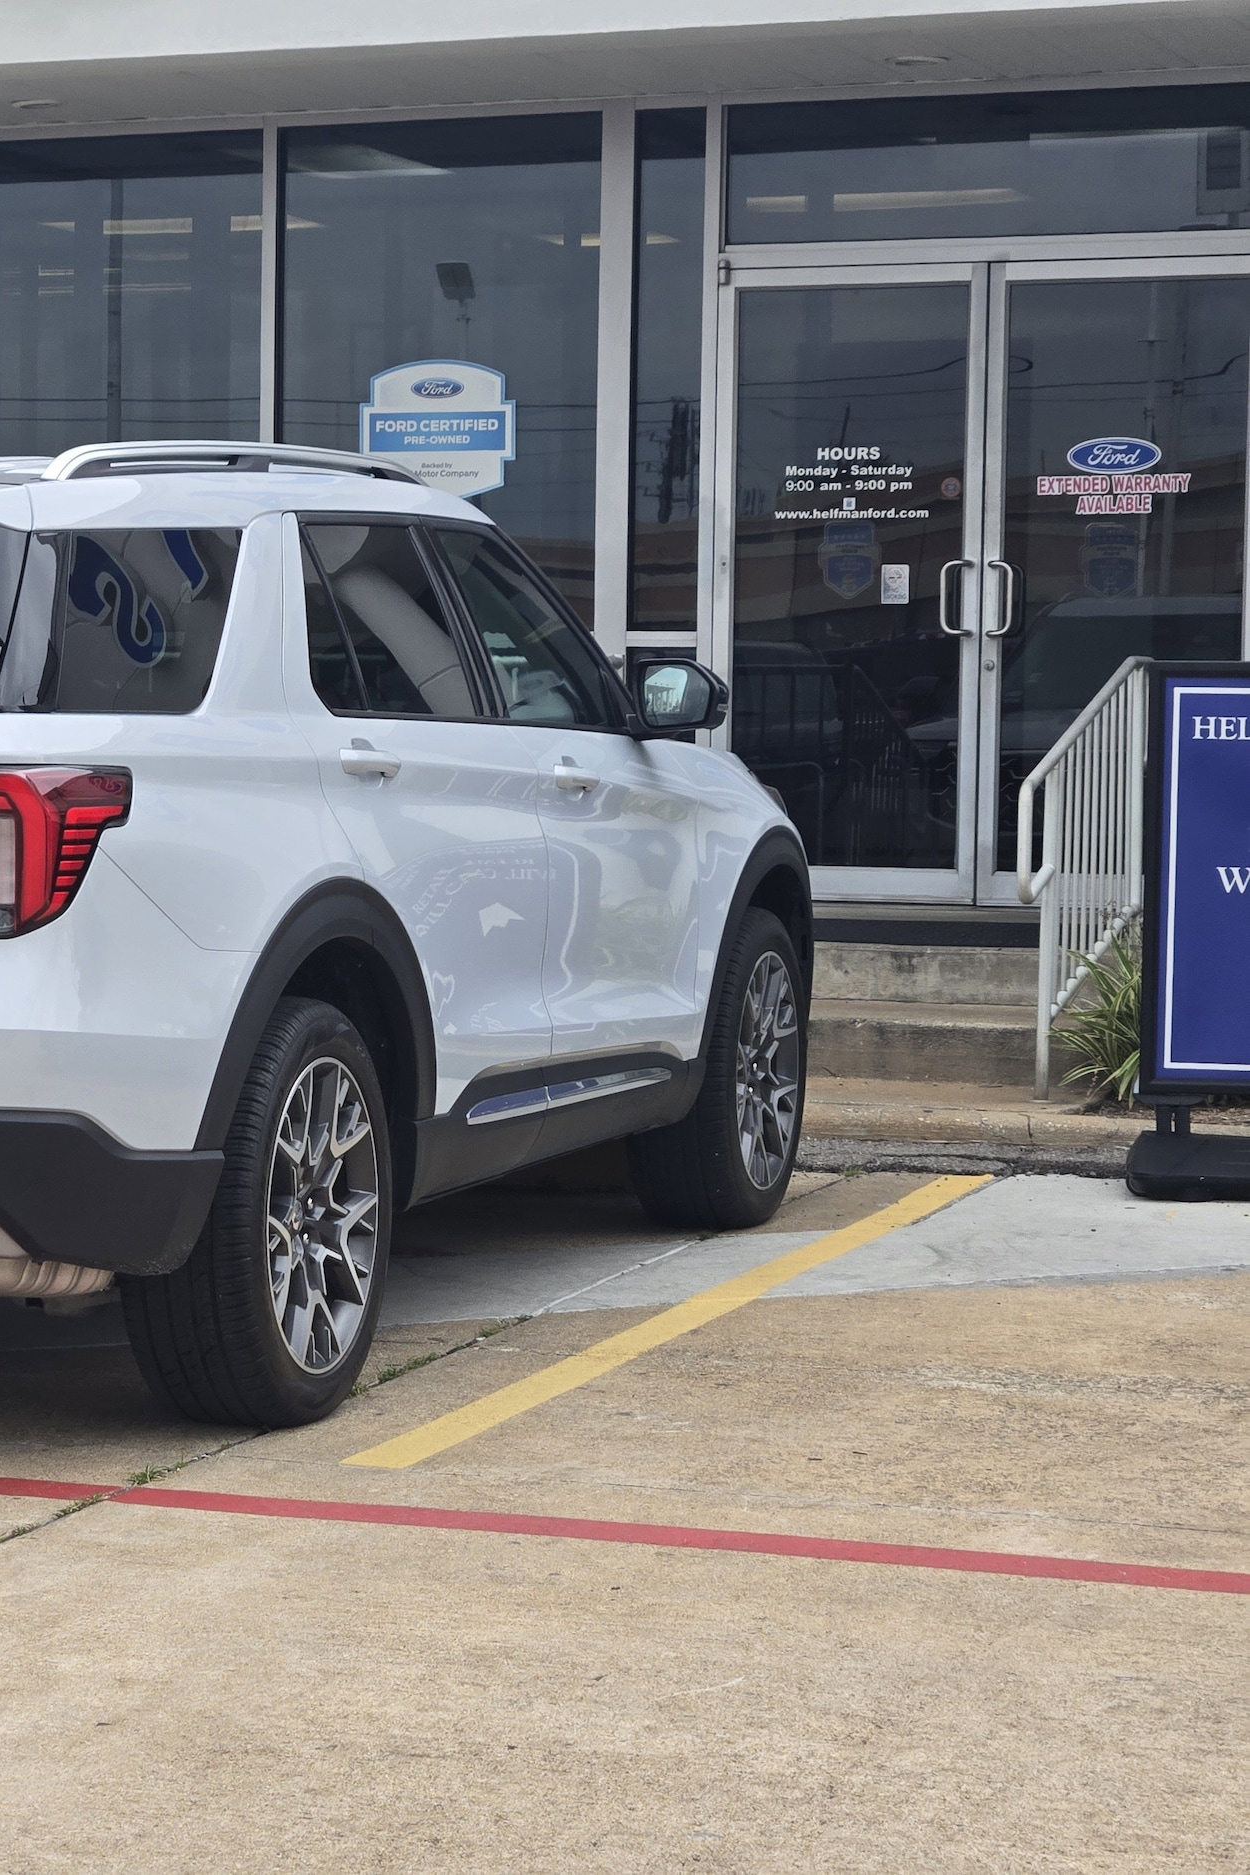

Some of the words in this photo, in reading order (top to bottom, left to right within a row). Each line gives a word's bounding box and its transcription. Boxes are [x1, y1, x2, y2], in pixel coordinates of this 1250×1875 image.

[375, 420, 417, 433] FORD
[419, 418, 499, 432] CERTIFIED
[404, 435, 470, 445] PRE-OWNED
[816, 446, 881, 461] HOURS
[414, 470, 439, 478] Motor
[440, 469, 479, 479] Company
[785, 465, 839, 478] Monday
[850, 464, 913, 477] Saturday
[785, 480, 815, 492] 9:00
[819, 481, 842, 491] am
[855, 479, 886, 491] 9:00
[890, 480, 913, 492] pm
[1037, 475, 1110, 495] EXTENDED
[1112, 473, 1191, 494] WARRANTY
[1076, 494, 1152, 515] AVAILABLE
[774, 507, 929, 520] www.helfmanford.com
[1191, 716, 1250, 740] HEL
